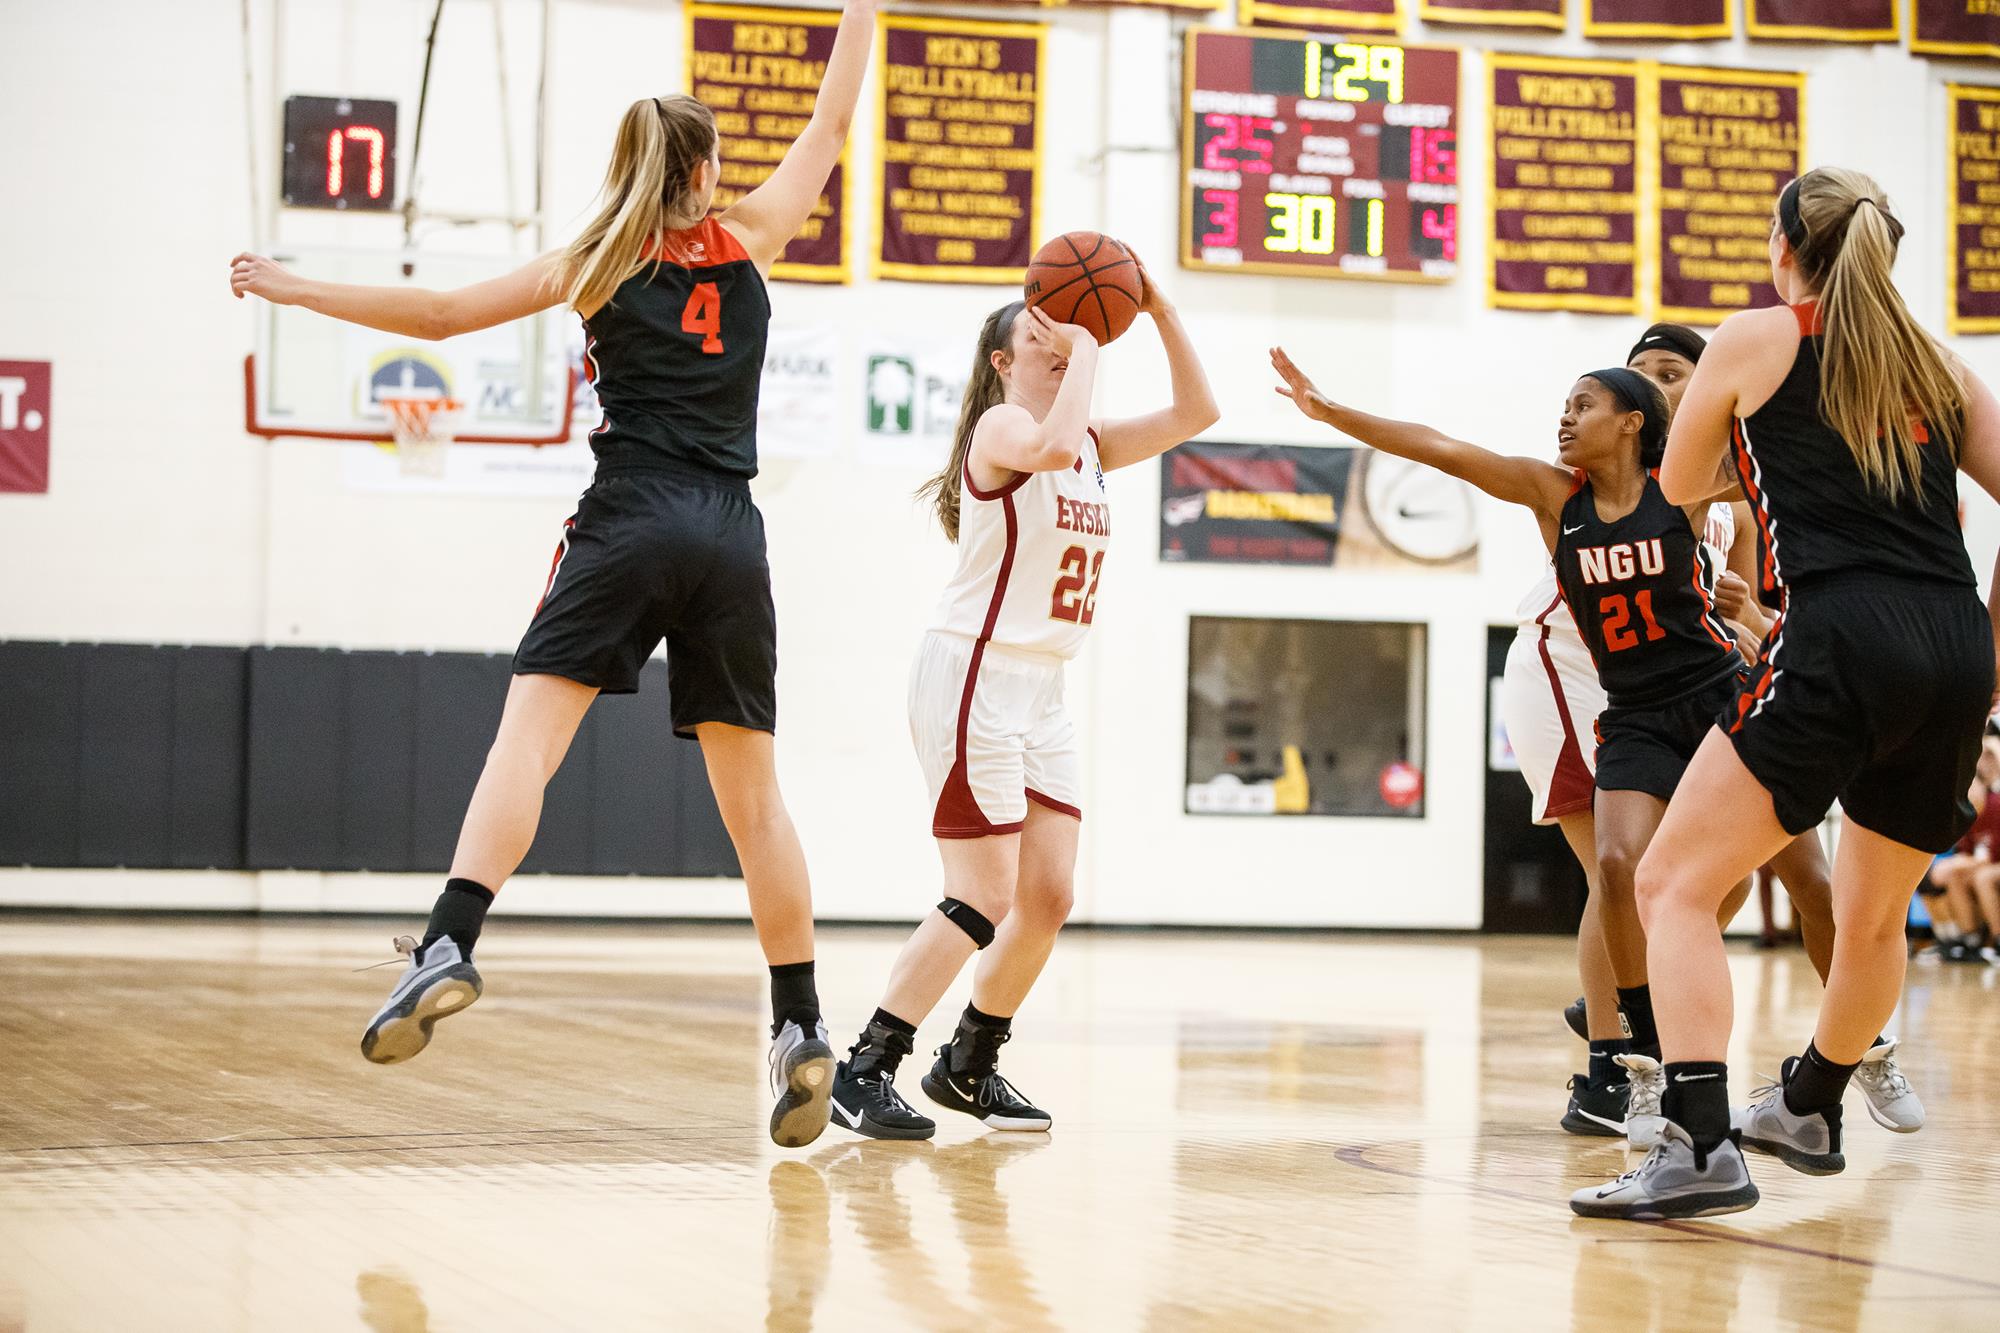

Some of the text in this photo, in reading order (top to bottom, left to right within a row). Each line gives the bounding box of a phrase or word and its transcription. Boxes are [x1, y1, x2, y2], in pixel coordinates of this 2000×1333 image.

[1304, 41, 1404, 104] 1:29
[327, 125, 384, 199] 17
[1204, 113, 1273, 174] 25
[1203, 189, 1239, 247] 3
[1264, 192, 1335, 255] 30
[1366, 198, 1384, 257] 1
[1423, 203, 1456, 262] 4
[681, 282, 724, 353] 4
[1577, 538, 1664, 585] NGU
[1600, 589, 1666, 652] 21
